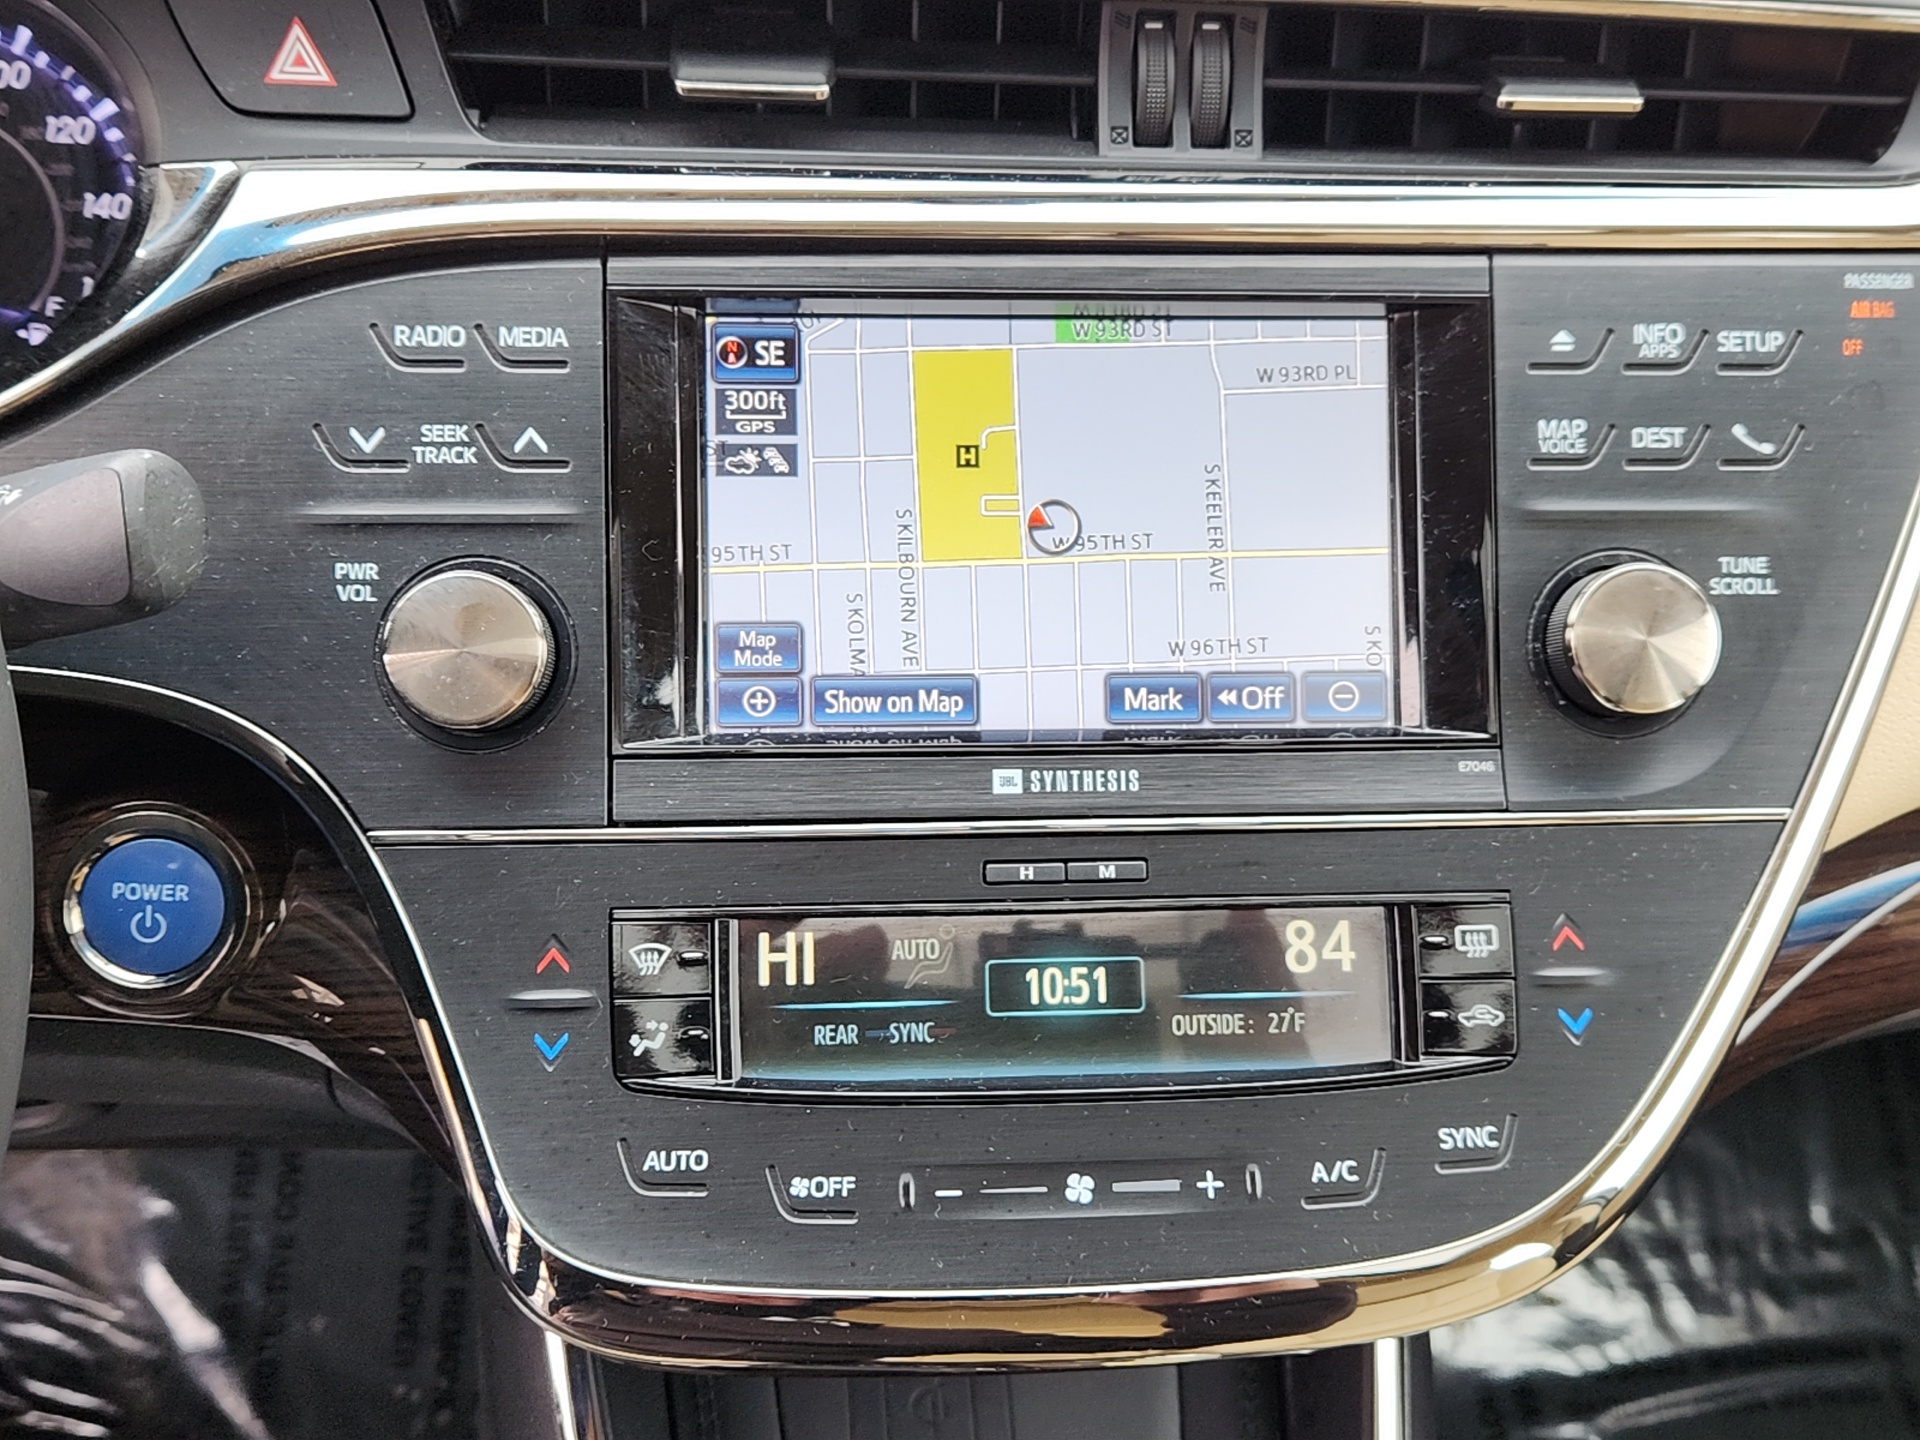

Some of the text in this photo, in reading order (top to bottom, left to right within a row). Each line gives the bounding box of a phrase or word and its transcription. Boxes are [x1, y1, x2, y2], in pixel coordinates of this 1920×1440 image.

[45, 115, 96, 145] 120
[83, 192, 132, 220] 140
[1843, 272, 1914, 289] PASSENGER
[394, 325, 466, 347] RADIO
[499, 326, 569, 348] MEDIA
[1073, 322, 1091, 338] W
[1095, 319, 1146, 338] 93RD
[1633, 323, 1686, 345] INFO
[1638, 344, 1680, 358] APPS
[1717, 331, 1785, 352] SETUP
[1842, 339, 1863, 356] OFF
[726, 340, 786, 366] N SE
[1256, 364, 1357, 383] W 93RD PL
[725, 390, 787, 411] 300ft
[420, 424, 470, 442] SEEK
[735, 420, 776, 434] GPS
[1537, 419, 1588, 439] MAP
[1631, 427, 1687, 448] DEST
[411, 446, 478, 464] TRACK
[1538, 438, 1587, 454] VOICE
[1204, 479, 1224, 550] KEELER
[1075, 534, 1125, 552] 95TH
[1131, 533, 1153, 550] ST
[712, 544, 793, 563] 95TH ST
[334, 563, 380, 580] PWR
[896, 524, 917, 623] KILBOURN
[1208, 556, 1226, 593] AVE
[1718, 556, 1771, 574] TUNE
[335, 585, 378, 602] VOL
[1709, 577, 1780, 595] SCROLL
[739, 631, 776, 649] Map
[901, 630, 919, 667] AVE
[1168, 637, 1269, 657] W 96TH ST
[734, 650, 782, 667] Mode
[825, 690, 963, 717] Show on Map
[1124, 687, 1183, 712] Mark
[1241, 686, 1285, 710] Off
[1030, 769, 1140, 792] SYNTHESIS
[1019, 865, 1034, 880] H
[1098, 864, 1116, 879] M
[111, 882, 190, 902] POWER
[892, 939, 940, 960] AUTO
[1284, 919, 1356, 973] 84
[758, 931, 815, 986] HI
[1025, 966, 1108, 1006] 10:51
[814, 1024, 859, 1046] REAR
[889, 1022, 936, 1044] SYNC
[1438, 1125, 1500, 1151] SYNC
[642, 1149, 709, 1172] AUTO
[1311, 1159, 1360, 1184] A/C
[810, 1175, 857, 1198] OFF
